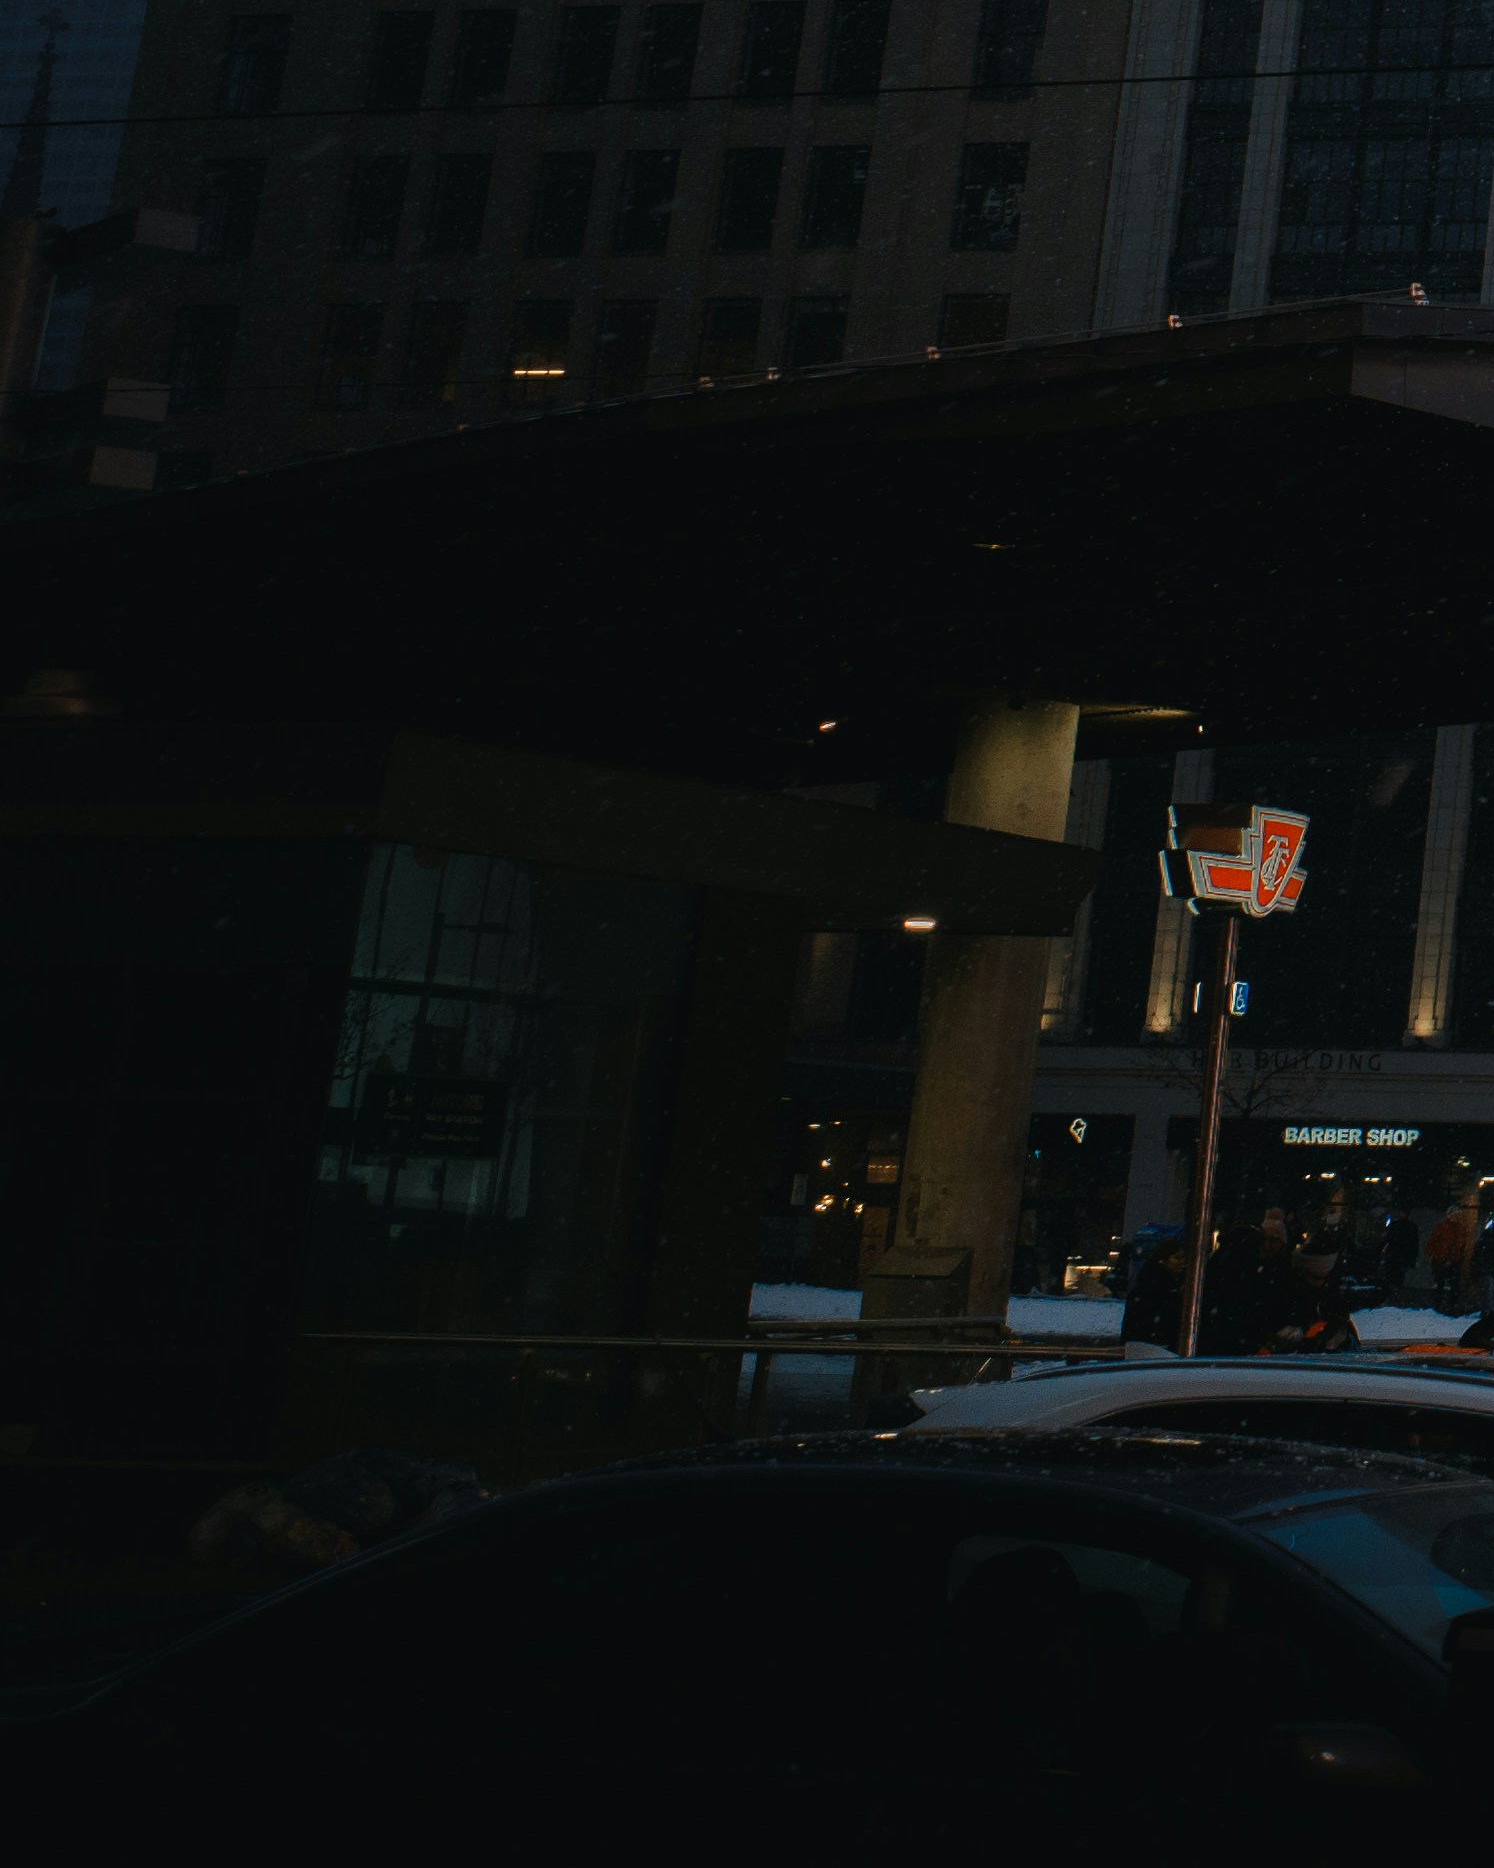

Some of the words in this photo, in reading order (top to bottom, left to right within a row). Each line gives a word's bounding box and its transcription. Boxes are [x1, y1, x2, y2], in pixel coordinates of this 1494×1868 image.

[1256, 1051, 1383, 1072] BUILDING
[1283, 1126, 1363, 1145] BARBER
[1366, 1128, 1420, 1147] SHOP
